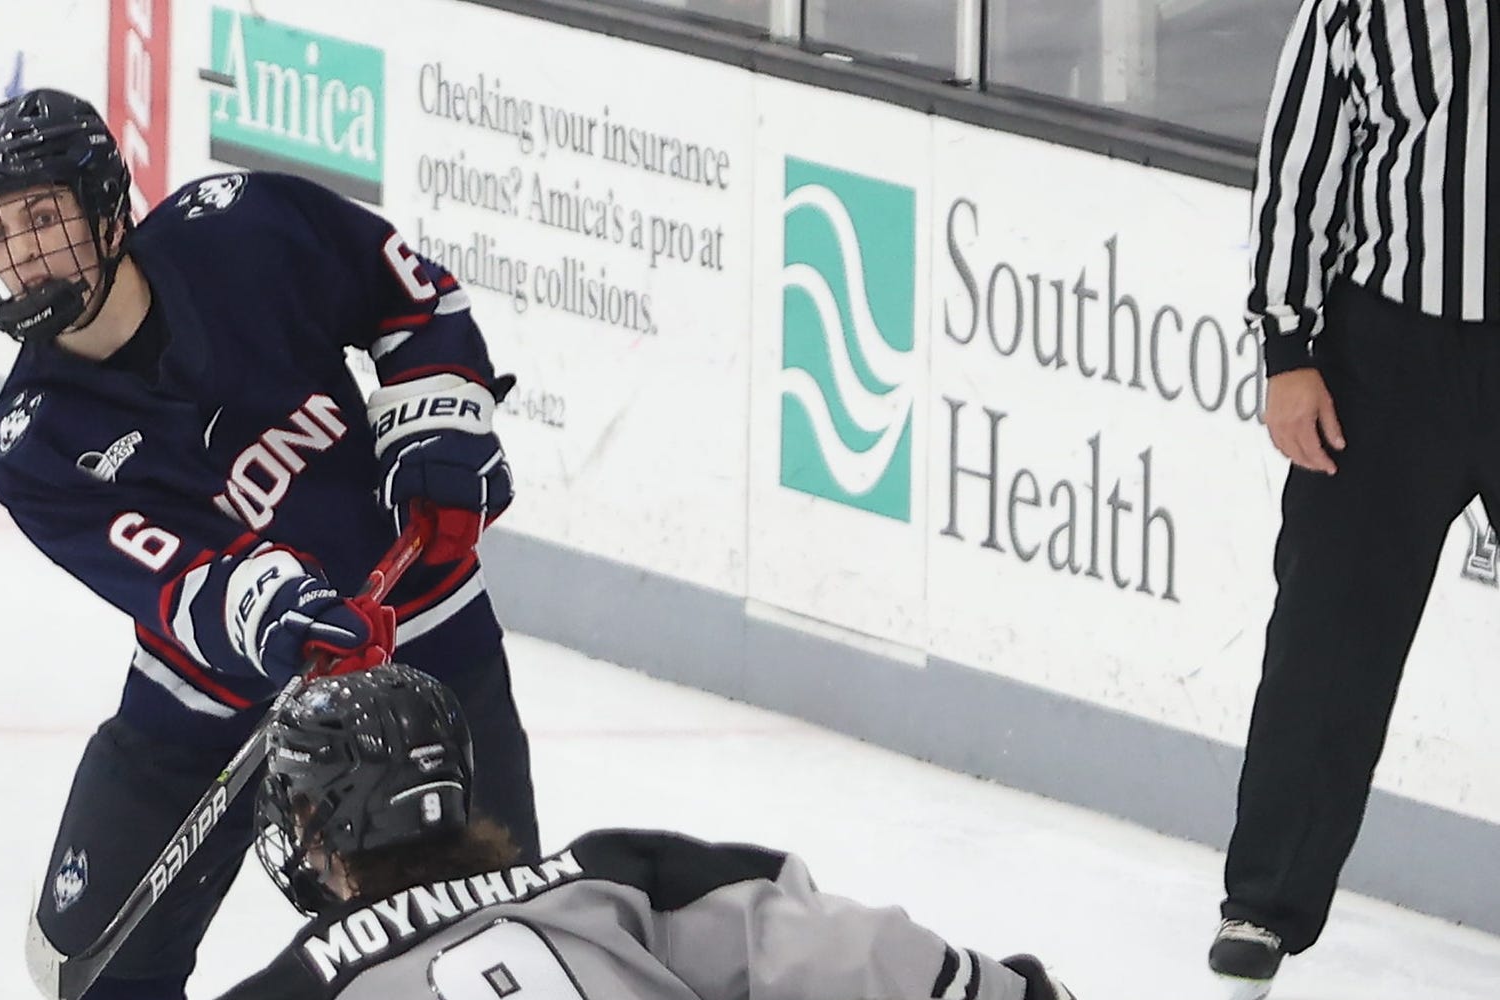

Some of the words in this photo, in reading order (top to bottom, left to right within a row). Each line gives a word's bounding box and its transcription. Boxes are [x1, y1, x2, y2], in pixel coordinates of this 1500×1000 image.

[213, 10, 377, 163] Amica
[419, 62, 531, 155] Checking
[538, 104, 597, 158] your
[602, 107, 730, 190] insurance
[418, 152, 523, 216] options?
[528, 184, 623, 245] Amica's
[630, 212, 643, 249] a
[650, 222, 695, 270] pro
[700, 222, 725, 272] at
[534, 256, 658, 335] collisions.
[943, 197, 1267, 425] Southcoa
[373, 397, 482, 440] AUER
[109, 510, 181, 572] 6
[940, 396, 1181, 603] Health
[422, 792, 442, 822] 9
[304, 848, 584, 984] MOYNIHAN
